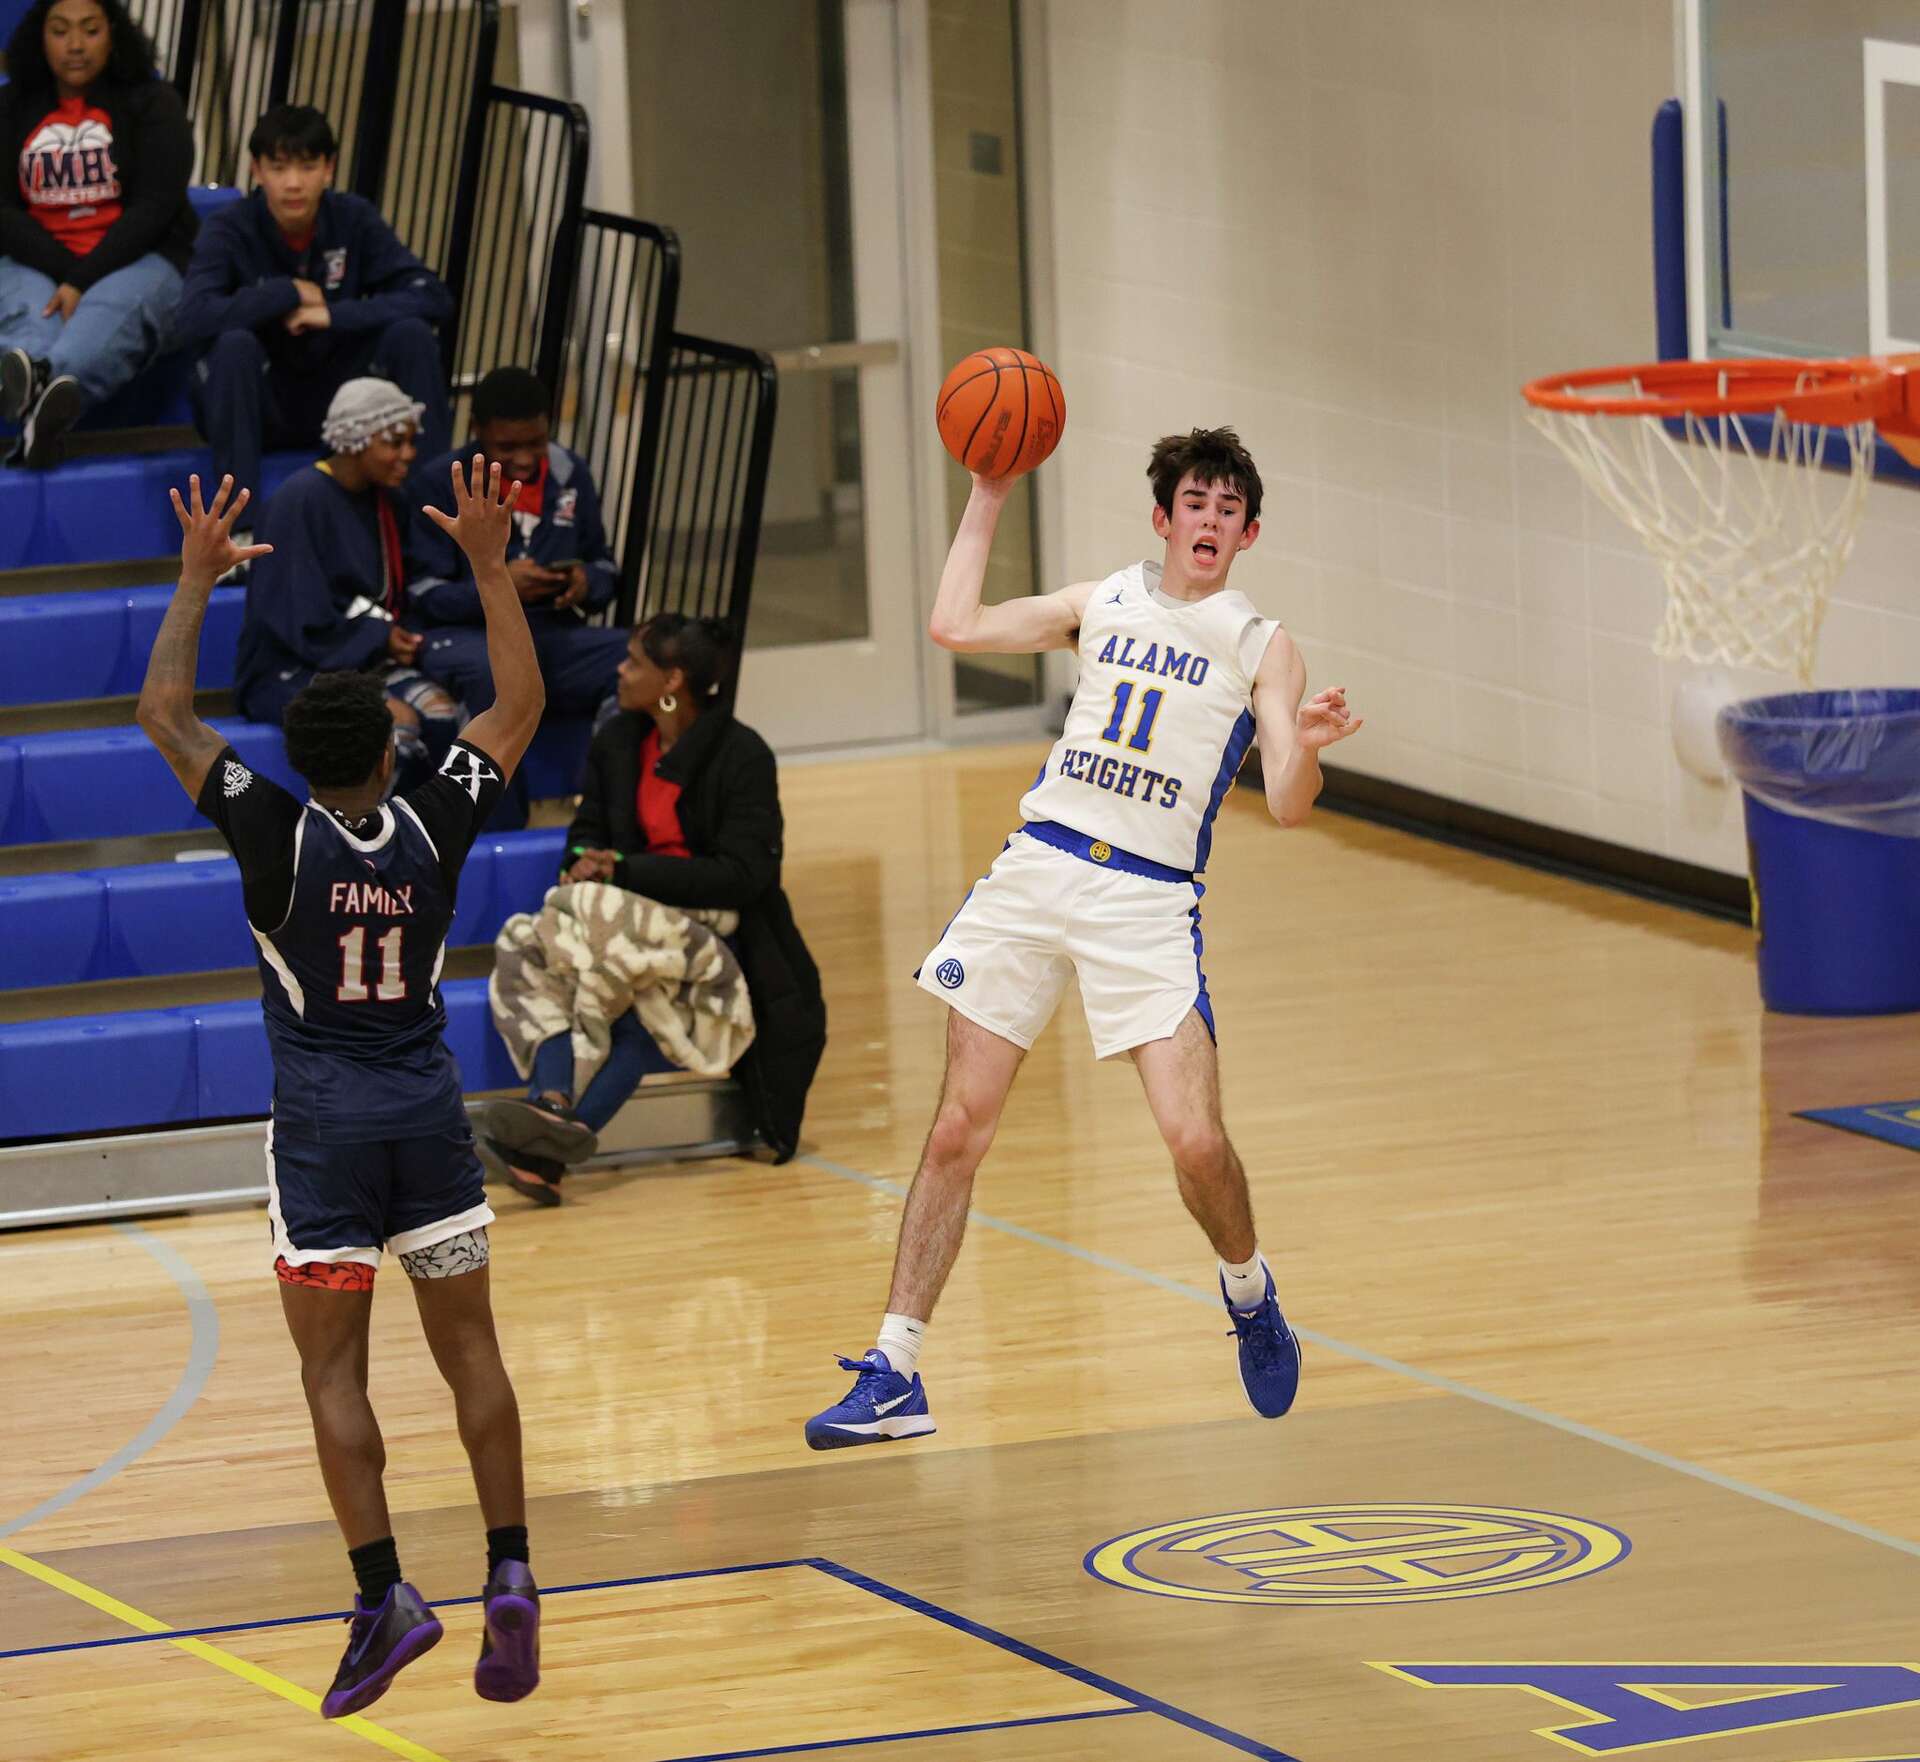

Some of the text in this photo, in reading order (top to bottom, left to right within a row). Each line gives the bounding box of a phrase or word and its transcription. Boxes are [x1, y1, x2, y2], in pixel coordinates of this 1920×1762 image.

[24, 147, 117, 188] MH
[1098, 634, 1210, 687] ALAMO
[1099, 678, 1167, 756] 11
[1059, 748, 1183, 810] HEIGHTS
[336, 924, 408, 1004] 11
